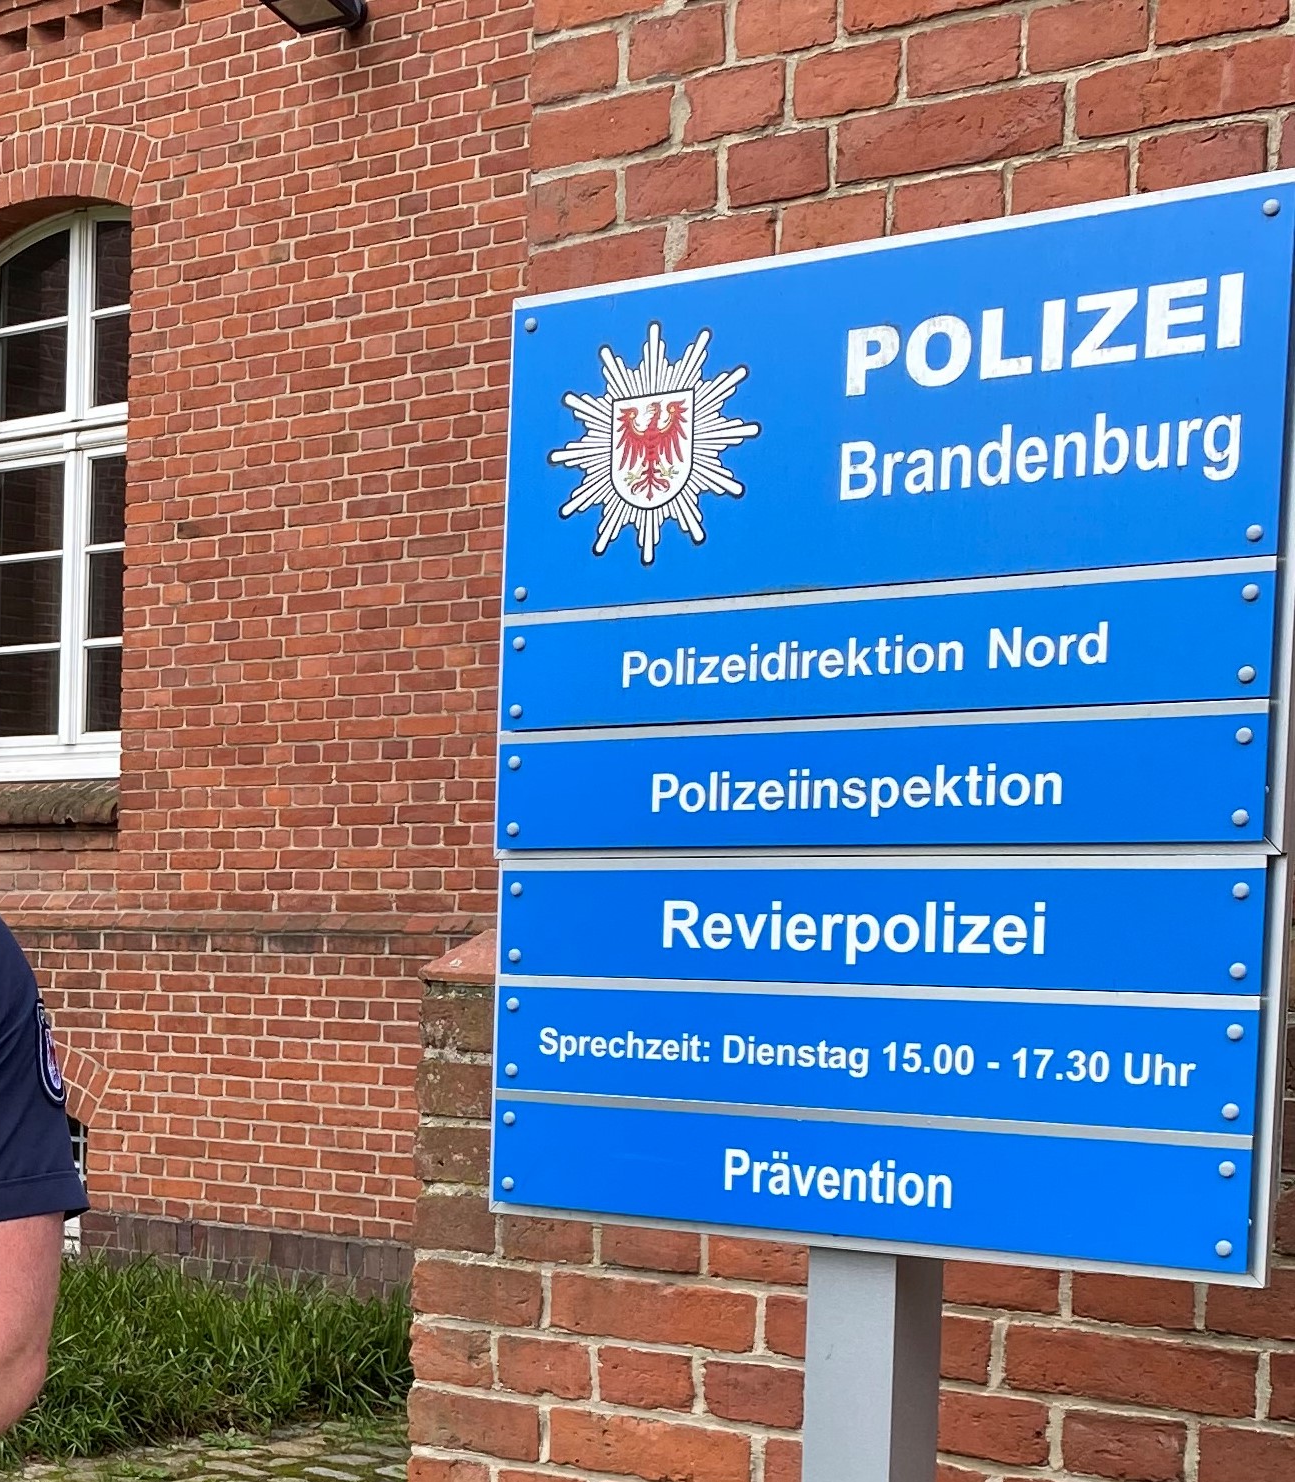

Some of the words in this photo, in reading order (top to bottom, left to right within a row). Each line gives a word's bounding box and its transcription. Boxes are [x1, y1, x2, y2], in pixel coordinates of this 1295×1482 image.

[844, 271, 1246, 398] POLIZEI
[838, 412, 1243, 502] Brandenburg
[621, 633, 965, 689] Polizeidirektion
[987, 621, 1110, 670] Nord
[650, 762, 1064, 819] Polizeiinspektion
[661, 899, 1047, 966] Revierpolizei
[538, 1026, 711, 1063] Sprechzeit:
[722, 1033, 870, 1079] Dienstag
[882, 1040, 976, 1077] 15.00
[986, 1060, 1001, 1070] -
[1011, 1046, 1111, 1084] 17.30
[1123, 1051, 1198, 1088] Uhr
[723, 1147, 953, 1210] Prävention
